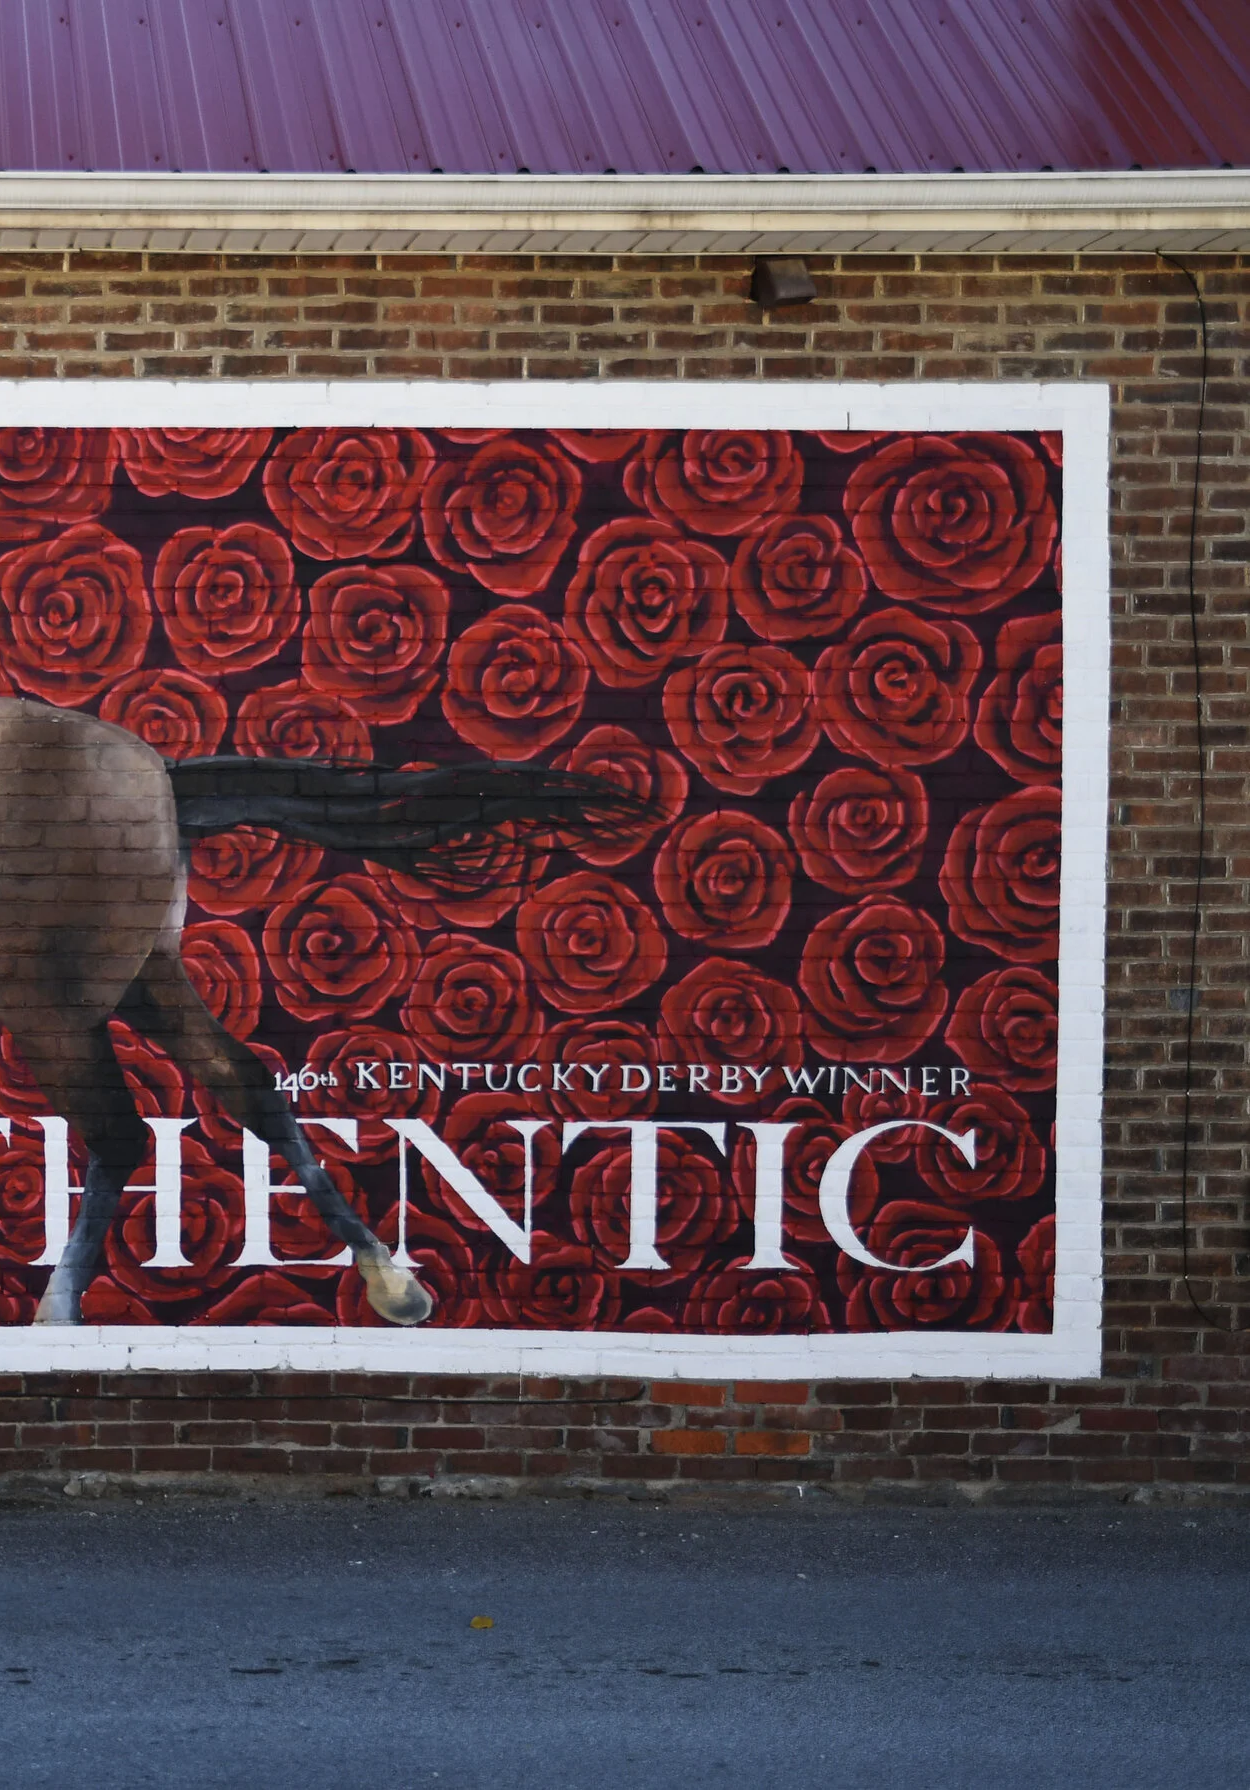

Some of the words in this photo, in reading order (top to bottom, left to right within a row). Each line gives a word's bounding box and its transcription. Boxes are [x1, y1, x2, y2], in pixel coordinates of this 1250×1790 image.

[274, 1062, 339, 1103] 146th
[354, 1061, 610, 1094] KENTUCKY
[619, 1063, 775, 1095] DERBY
[780, 1065, 972, 1097] WINNER
